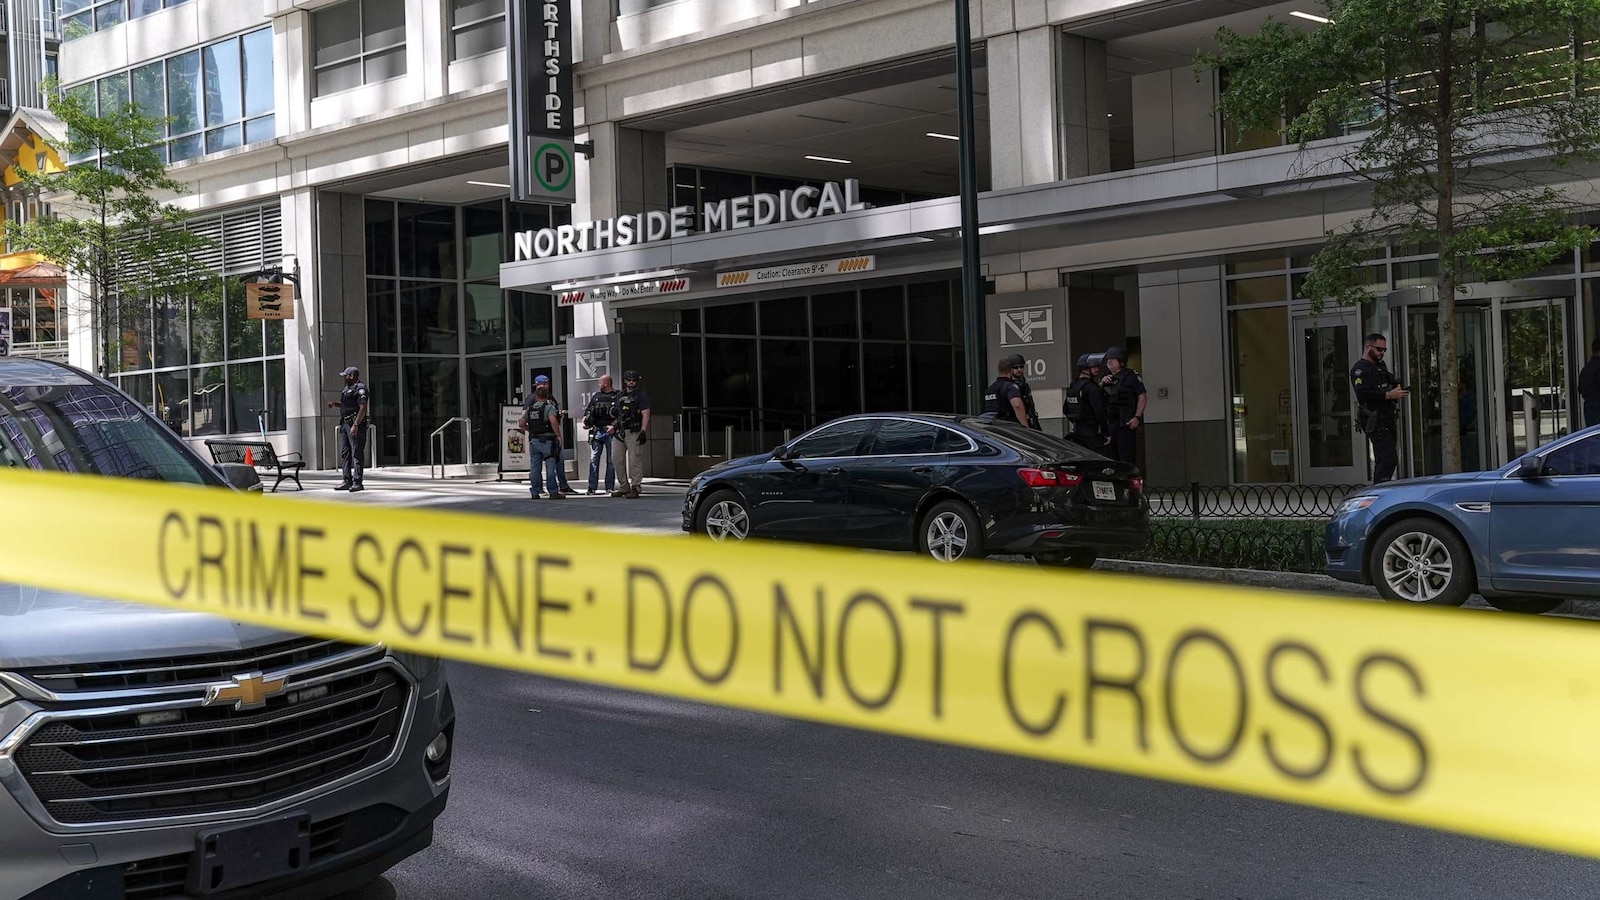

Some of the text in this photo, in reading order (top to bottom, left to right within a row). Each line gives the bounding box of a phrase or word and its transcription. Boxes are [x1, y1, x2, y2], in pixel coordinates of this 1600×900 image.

[543, 0, 562, 130] RTHSIDE
[545, 152, 564, 183] P
[514, 178, 866, 262] NORTHSIDE MEDICAL
[622, 287, 629, 296] Do
[641, 285, 654, 293] Enter
[757, 271, 781, 280] Caution:
[782, 267, 810, 277] Clearance
[158, 511, 1432, 798] CRIME SCENE: DO NOT CROSS
